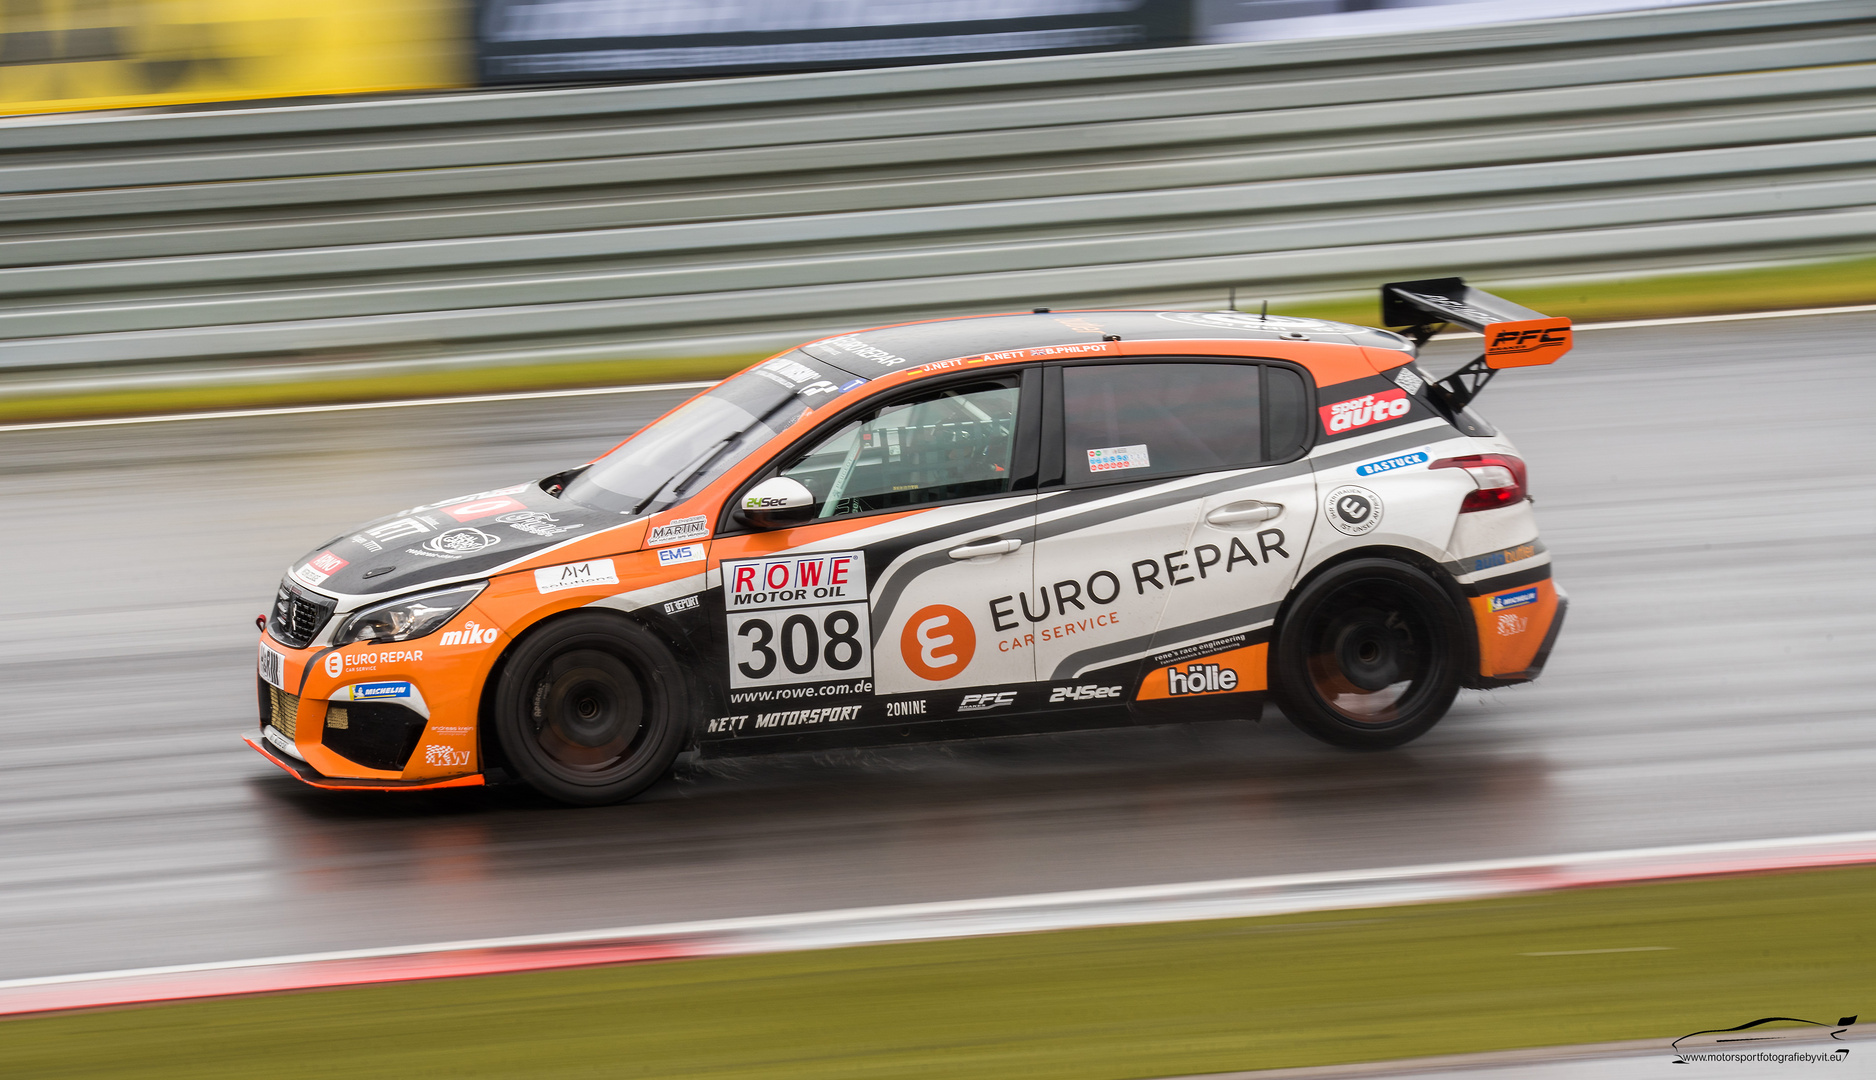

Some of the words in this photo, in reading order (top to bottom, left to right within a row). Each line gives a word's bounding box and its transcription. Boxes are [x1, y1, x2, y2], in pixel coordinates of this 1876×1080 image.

[1491, 327, 1571, 347] PFC
[859, 344, 906, 367] REPAR
[924, 359, 962, 372] J.NETT
[984, 351, 1025, 362] A.NETT
[1046, 344, 1107, 354] B.PHILPOT
[1329, 398, 1411, 432] auto
[1331, 395, 1375, 415] sport
[1363, 454, 1423, 475] BASTUCK
[746, 497, 787, 508] 24Sec
[653, 521, 705, 538] MARTINI
[660, 547, 692, 561] EMS
[561, 563, 591, 580] AM
[733, 557, 852, 593] ROWE
[988, 570, 1120, 632] EURO
[1131, 527, 1290, 595] REPAR
[734, 588, 807, 605] MOTOR
[814, 586, 846, 599] OIL
[439, 621, 498, 646] miko
[998, 634, 1034, 653] CAR
[1041, 611, 1120, 642] SERVICE
[737, 610, 863, 679] 308
[1154, 650, 1178, 661] rene's
[1180, 646, 1198, 656] race
[1199, 634, 1246, 651] engineering
[345, 653, 377, 666] EURO
[380, 650, 423, 663] REPAR
[1169, 665, 1237, 694] hölle
[365, 686, 407, 696] MICHELIN
[731, 680, 872, 703] www.rowe.com.de
[960, 691, 1018, 706] PFC
[1049, 684, 1122, 702] 24Sec
[707, 715, 748, 733] NETT
[755, 705, 862, 729] MOTORSPORT
[886, 700, 927, 717] 20NINE
